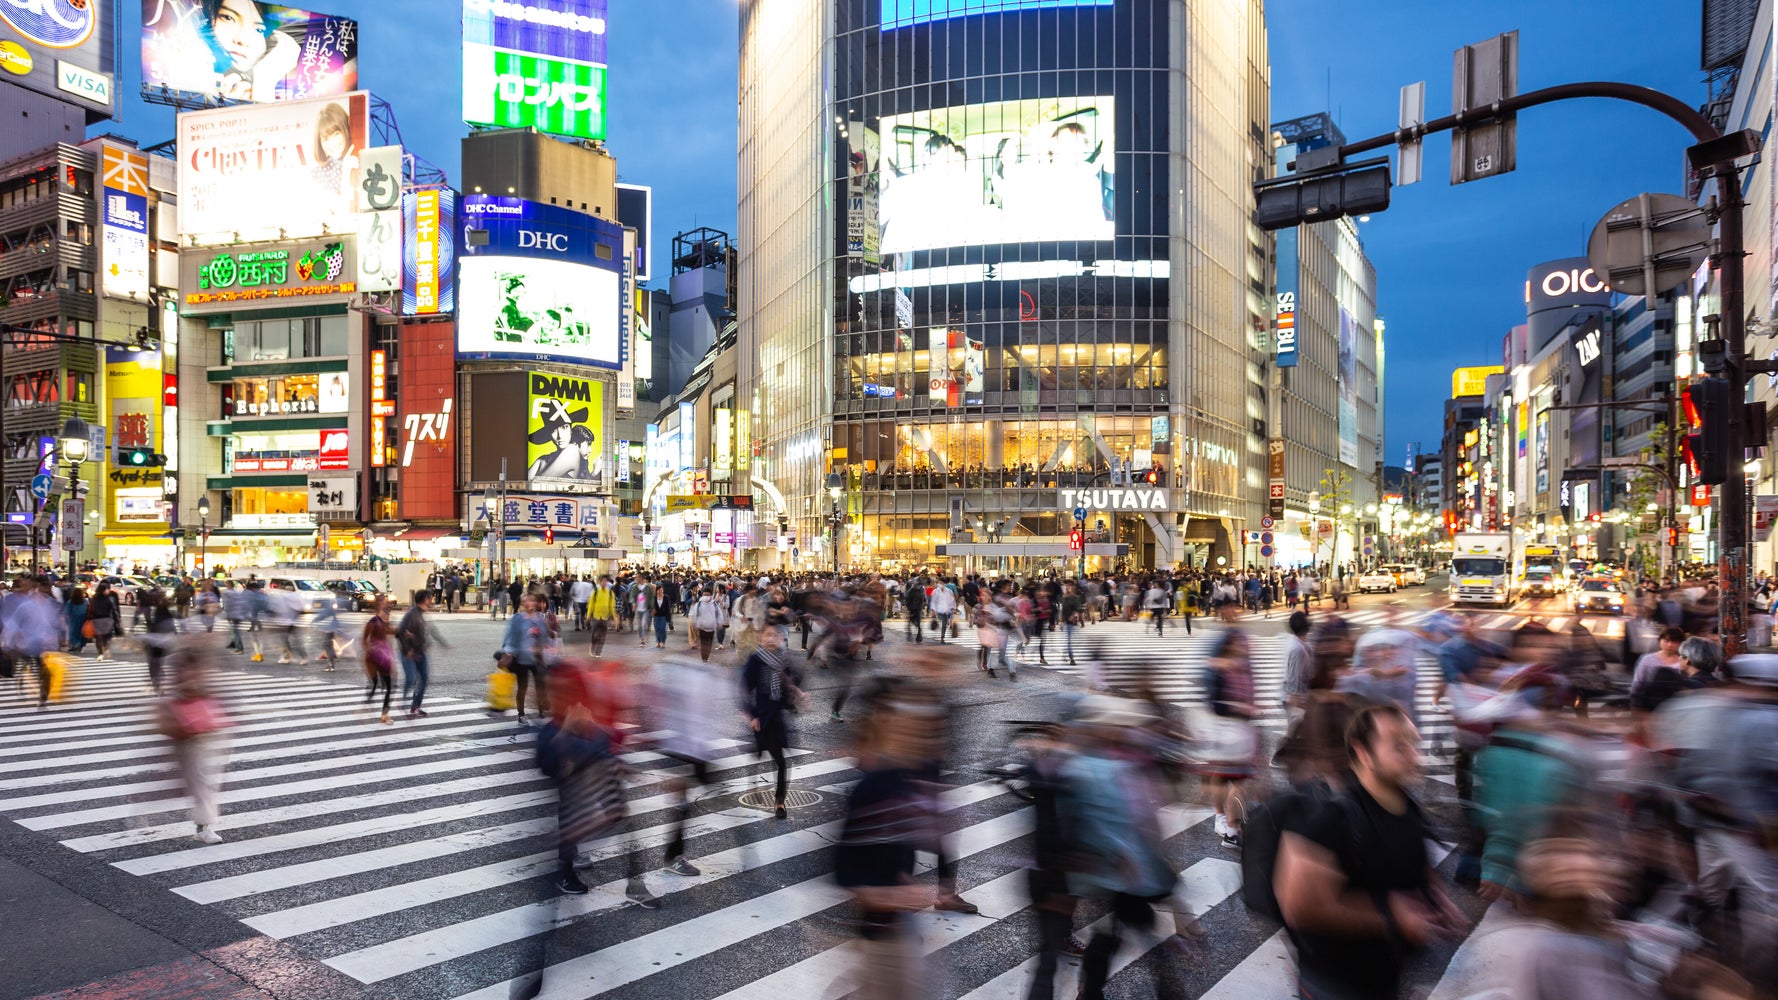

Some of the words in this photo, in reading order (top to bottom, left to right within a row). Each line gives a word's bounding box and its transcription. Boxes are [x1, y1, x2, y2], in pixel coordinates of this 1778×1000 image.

[65, 72, 107, 97] VISA
[190, 122, 216, 133] SPICY
[103, 151, 148, 192] 本
[465, 203, 486, 213] DHC
[486, 203, 523, 215] Channel
[518, 230, 569, 251] DHC
[238, 261, 288, 287] 西村
[1276, 291, 1295, 354] SEIBU
[536, 353, 551, 361] DHC
[531, 374, 591, 402] DMM
[236, 398, 316, 416] Euphoria
[531, 397, 572, 424] FX
[118, 412, 150, 447] 薬
[402, 398, 453, 468] クスリ
[316, 490, 343, 506] 松川
[1061, 490, 1167, 509] TSUTAYA
[65, 504, 76, 546] 道玄坂
[475, 500, 598, 526] 大盛堂書店
